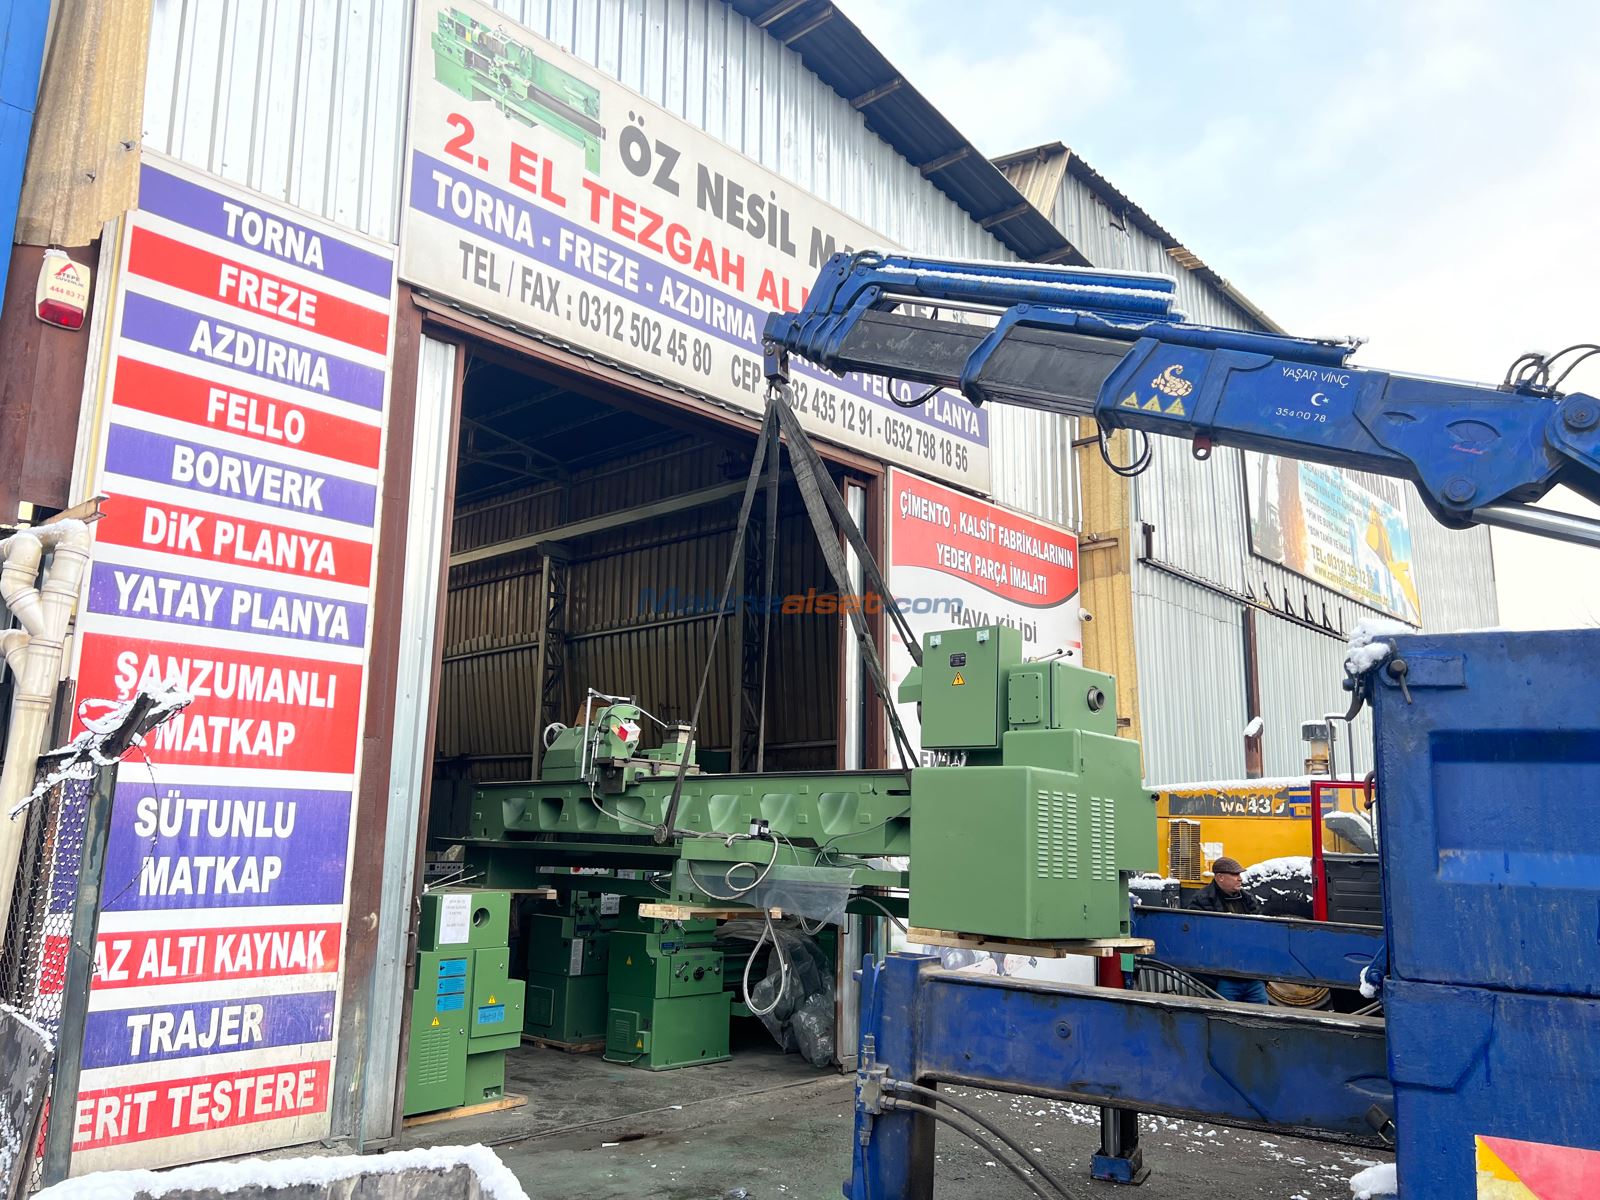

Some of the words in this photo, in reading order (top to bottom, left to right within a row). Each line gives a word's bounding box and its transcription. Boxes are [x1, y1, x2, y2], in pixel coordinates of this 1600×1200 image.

[444, 112, 489, 172] 2.
[509, 142, 566, 208] EL
[582, 178, 744, 292] TEZGAH
[619, 110, 681, 197] ÖZ
[697, 162, 796, 257] NESİL
[223, 202, 324, 270] TORNA
[219, 263, 317, 326] FREZE
[432, 170, 535, 248] TORNA
[559, 228, 640, 294] FREZE
[659, 276, 757, 344] AZDIRMA
[925, 397, 980, 437] PLANYA
[189, 320, 330, 391] AZDIRMA
[459, 239, 500, 293] TEL
[520, 265, 560, 319] FAX
[578, 290, 624, 341] 0312
[629, 313, 661, 357] 502
[667, 328, 687, 366] 45
[692, 337, 711, 376] 80
[731, 354, 761, 394] CEP
[812, 387, 836, 424] 435
[841, 398, 855, 431] 12
[859, 407, 873, 438] 91
[885, 415, 912, 453] 0532
[916, 429, 936, 462] 798
[939, 440, 952, 467] 18
[956, 446, 968, 473] 56
[1282, 367, 1317, 381] YAŞAR
[1321, 372, 1350, 388] VİNÇ
[207, 388, 305, 443] FELLO
[172, 444, 326, 511] BORVERK
[213, 521, 336, 575] PLANYA
[900, 488, 951, 528] ÇİMENTO
[960, 512, 996, 543] KALSİT
[998, 528, 1074, 569] FABRİKALARININ
[936, 543, 973, 573] YEDEK
[975, 557, 1008, 587] PARÇA
[1010, 561, 1048, 595] İMALATI
[114, 571, 227, 622] YATAY
[230, 589, 350, 640] PLANYA
[115, 651, 337, 709] ŞANZUMANLI
[155, 715, 296, 757] MATKAP
[134, 790, 296, 838] SÜTUNLU
[139, 856, 282, 896] MATKAP
[91, 939, 130, 981] AZ
[138, 933, 204, 979] ALTI
[214, 929, 327, 974] KAYNAK
[126, 1003, 264, 1056] TRAJER
[168, 1069, 317, 1128] TESTERE
